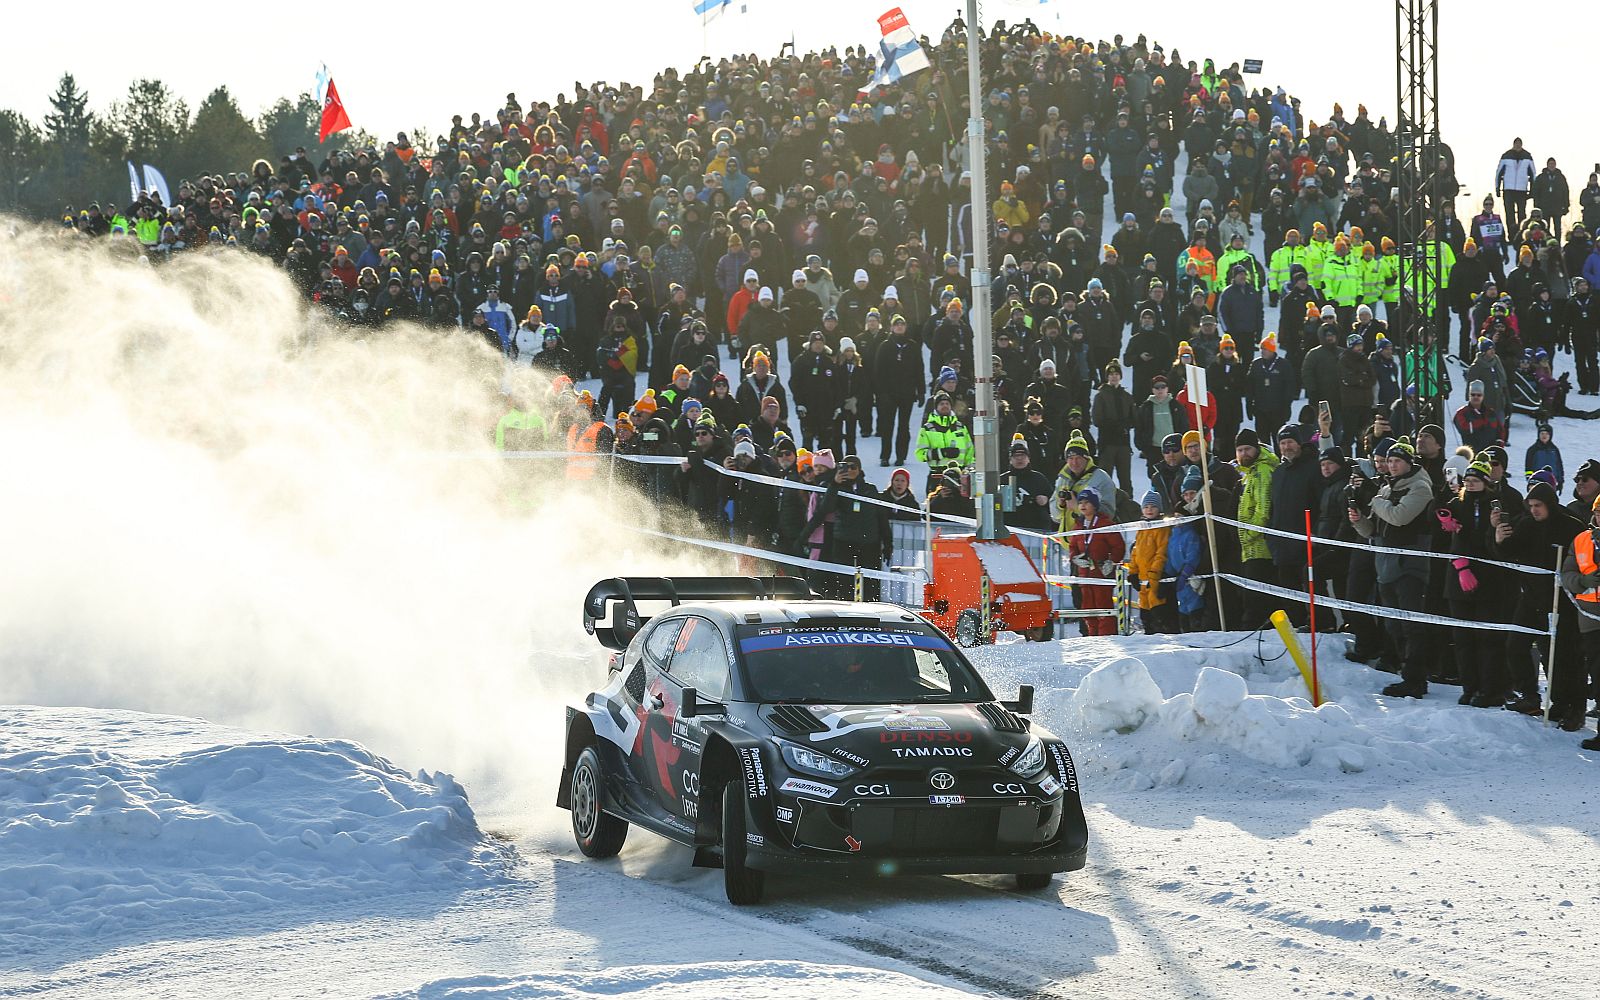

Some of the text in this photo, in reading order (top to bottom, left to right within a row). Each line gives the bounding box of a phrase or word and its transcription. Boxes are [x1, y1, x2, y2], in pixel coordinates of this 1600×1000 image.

[760, 627, 783, 636] GR
[880, 732, 973, 743] DENSO
[892, 747, 973, 758] TAMADIC
[739, 747, 758, 799] AUTOMOTIVE
[750, 747, 769, 797] Panasonic
[1049, 745, 1068, 790] Panasonic
[1058, 744, 1077, 792] AUTOMOTIVE
[776, 808, 793, 822] OMP
